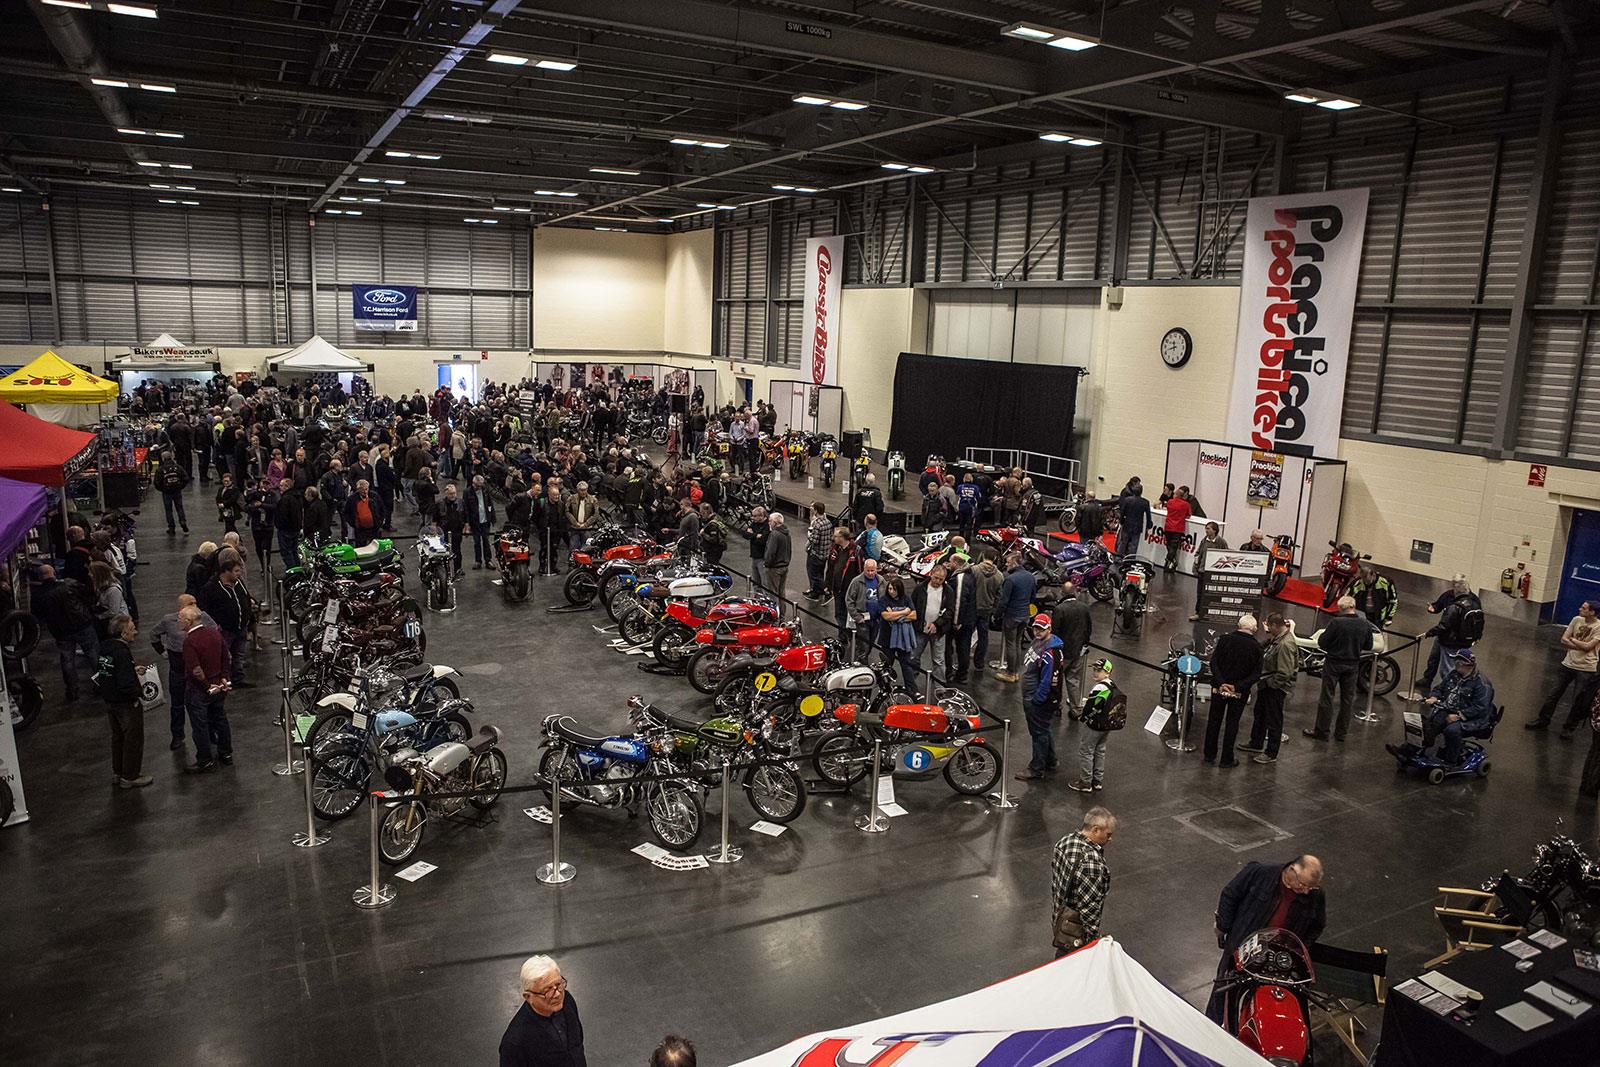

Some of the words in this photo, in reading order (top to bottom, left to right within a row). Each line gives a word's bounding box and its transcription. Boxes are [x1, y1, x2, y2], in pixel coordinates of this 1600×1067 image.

[787, 22, 804, 32] SWL
[806, 26, 831, 38] 1000kg
[815, 245, 832, 328] Classic
[372, 291, 399, 303] Ford
[1273, 204, 1344, 458] Practical
[133, 347, 214, 355] BikersWear.co.uk
[812, 327, 828, 385] Bike
[1251, 460, 1282, 473] Practical
[405, 620, 421, 638] 176
[1186, 657, 1193, 673] 1
[760, 675, 770, 689] 7
[911, 751, 923, 769] 6
